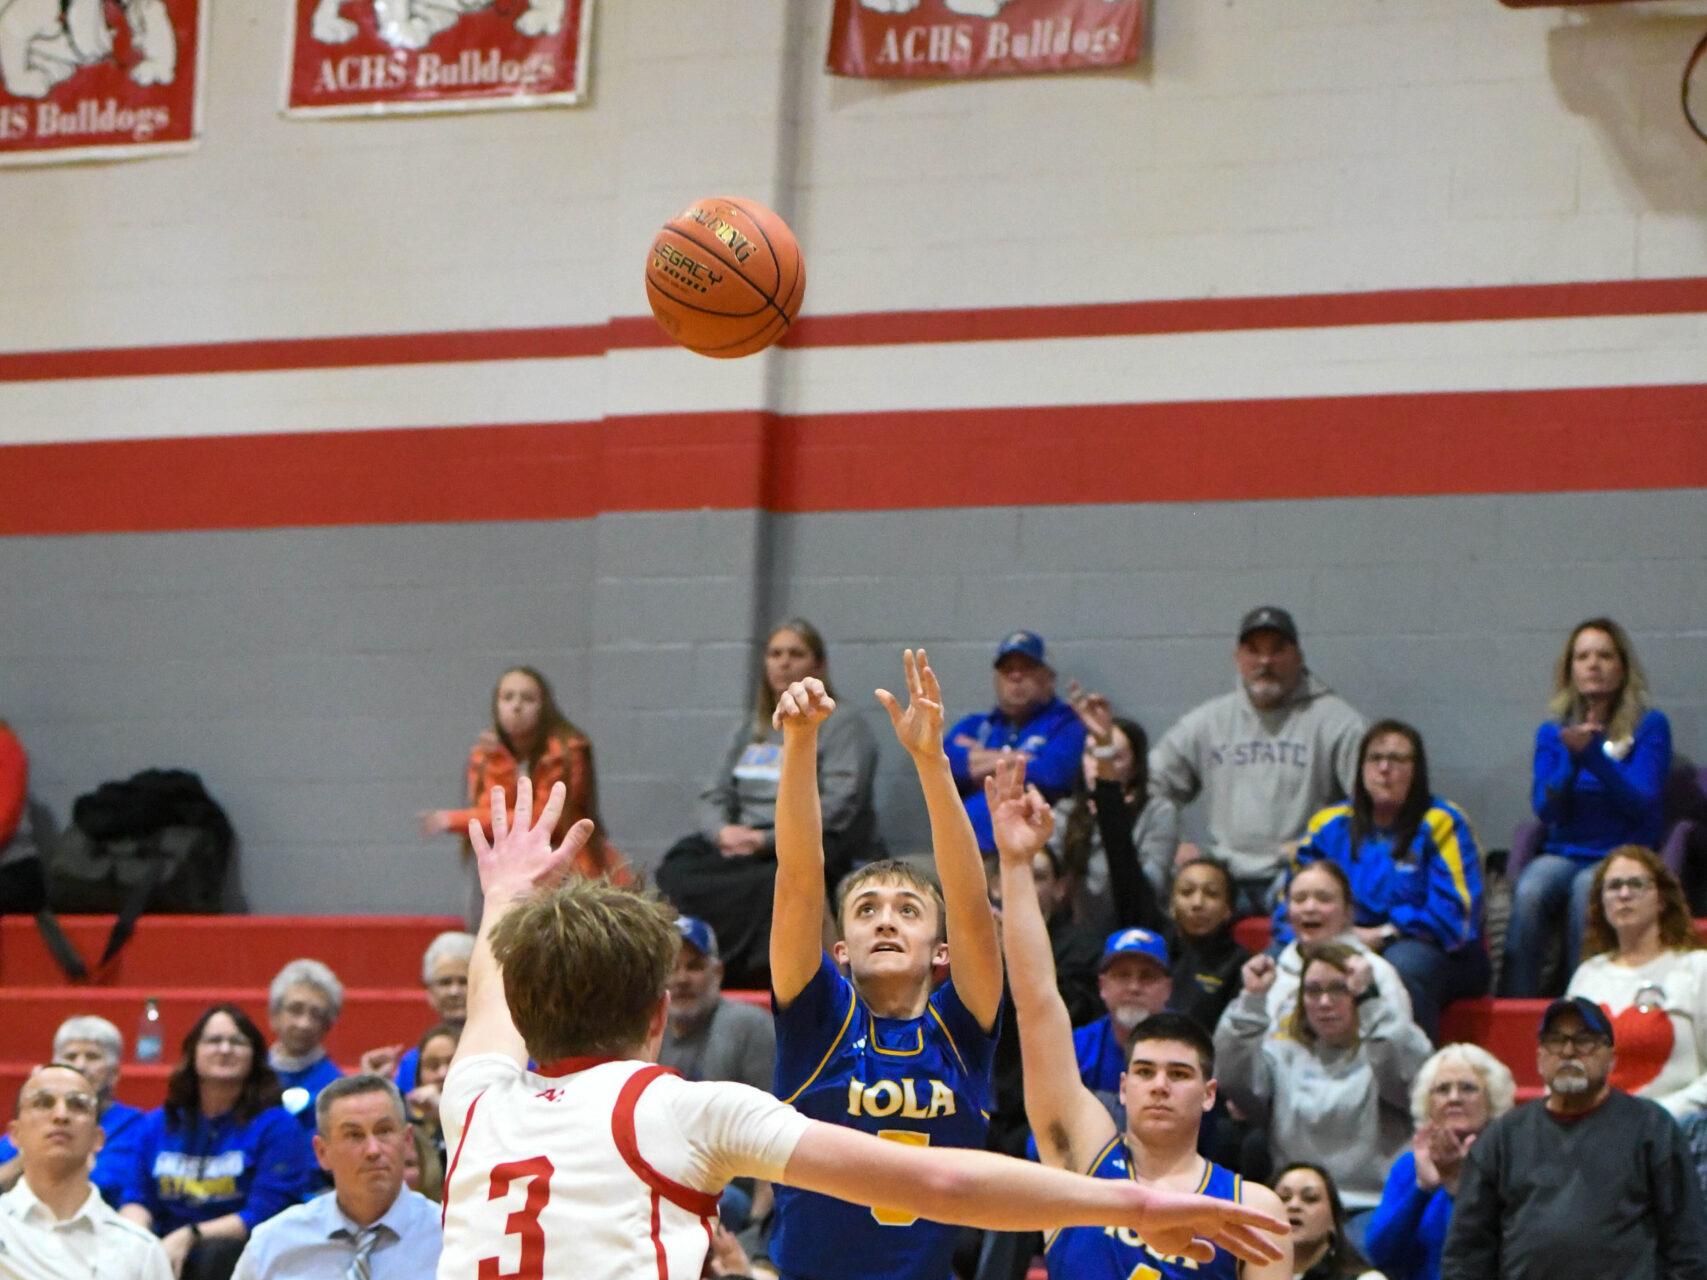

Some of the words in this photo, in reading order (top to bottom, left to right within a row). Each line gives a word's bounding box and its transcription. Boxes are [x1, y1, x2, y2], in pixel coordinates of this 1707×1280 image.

[876, 22, 973, 64] ACHS
[985, 17, 1121, 64] Bulldogs
[312, 50, 409, 94] ACHS
[414, 46, 557, 87] Bulldogs
[36, 98, 171, 142] Bulldogs
[653, 239, 724, 287] LEGACY
[847, 1075, 957, 1119] IOLA
